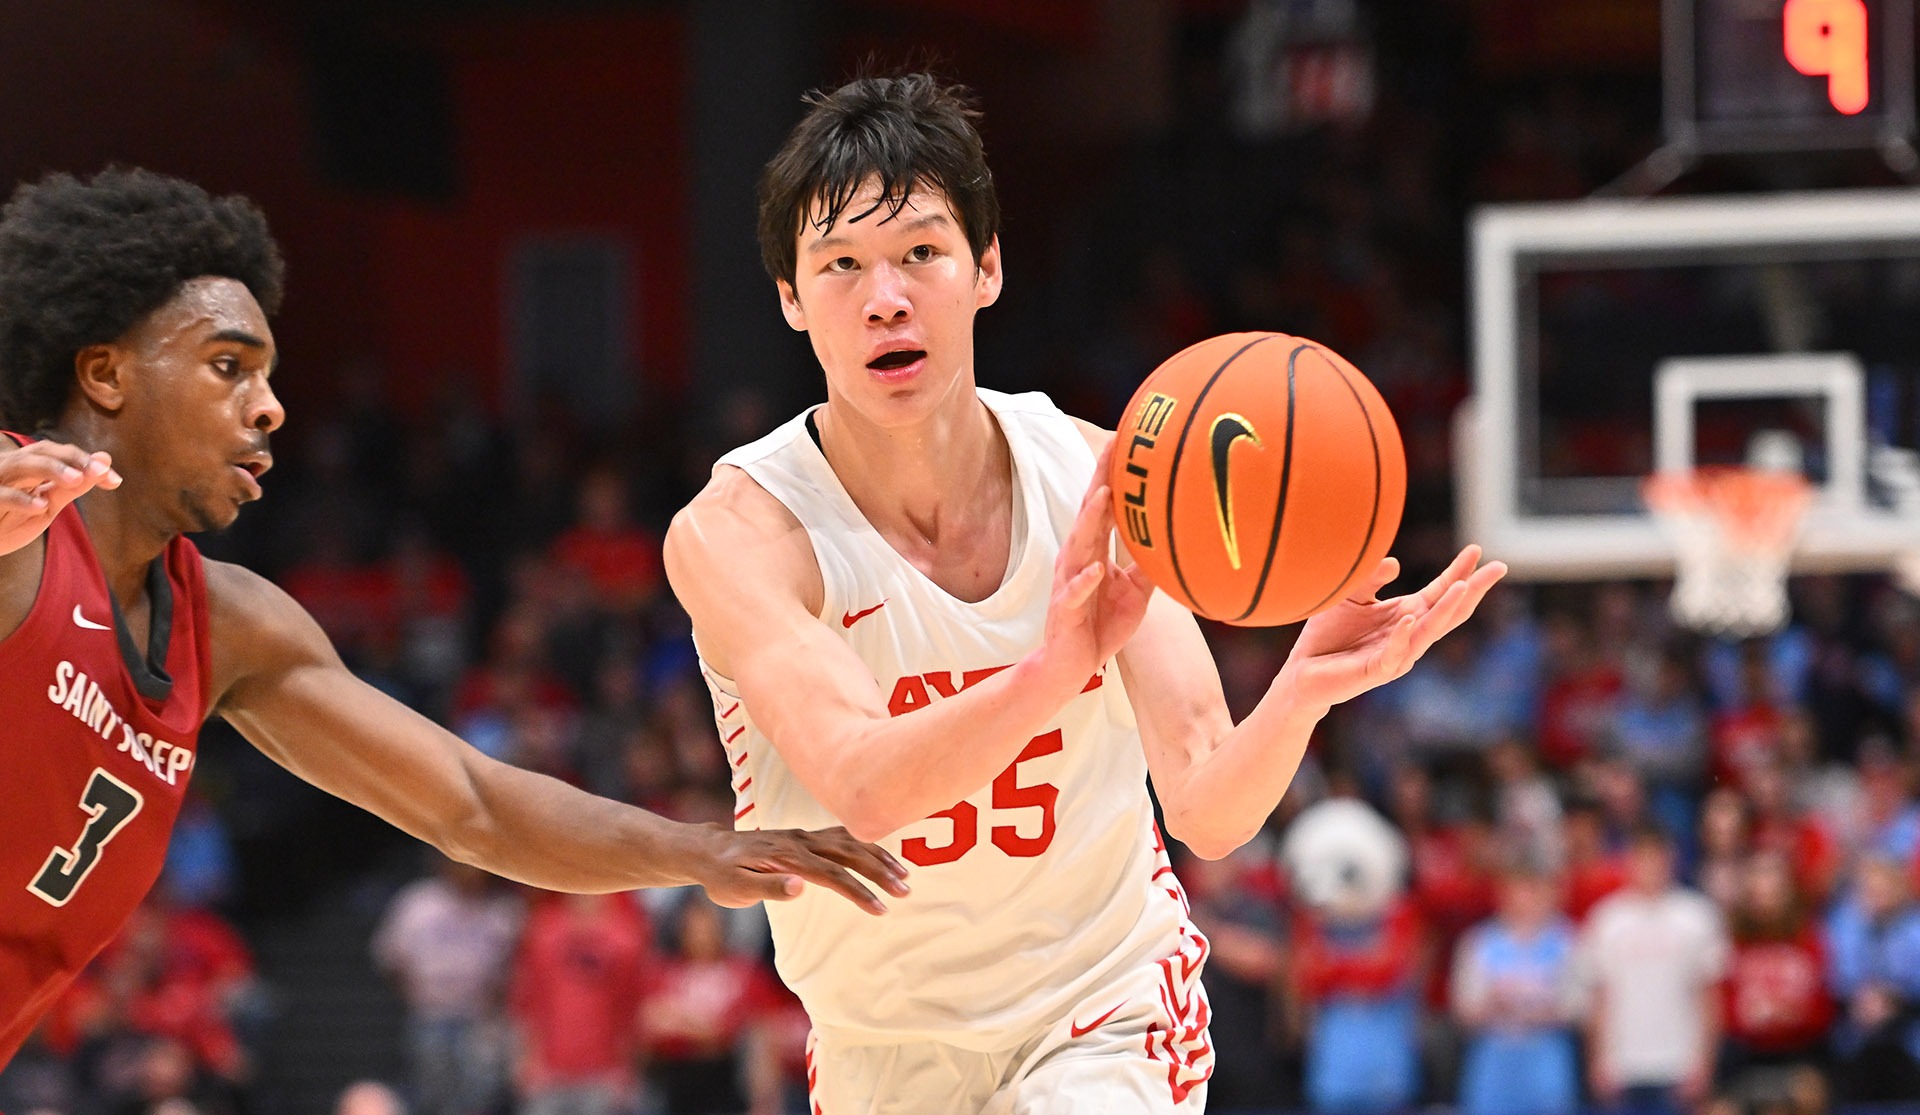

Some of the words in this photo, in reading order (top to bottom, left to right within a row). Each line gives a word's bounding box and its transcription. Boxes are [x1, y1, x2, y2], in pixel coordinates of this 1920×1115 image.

[1783, 0, 1869, 116] 9
[1124, 392, 1177, 549] ELITE
[48, 660, 123, 741] SAINT
[116, 722, 196, 786] JOSEP
[25, 766, 144, 908] 3
